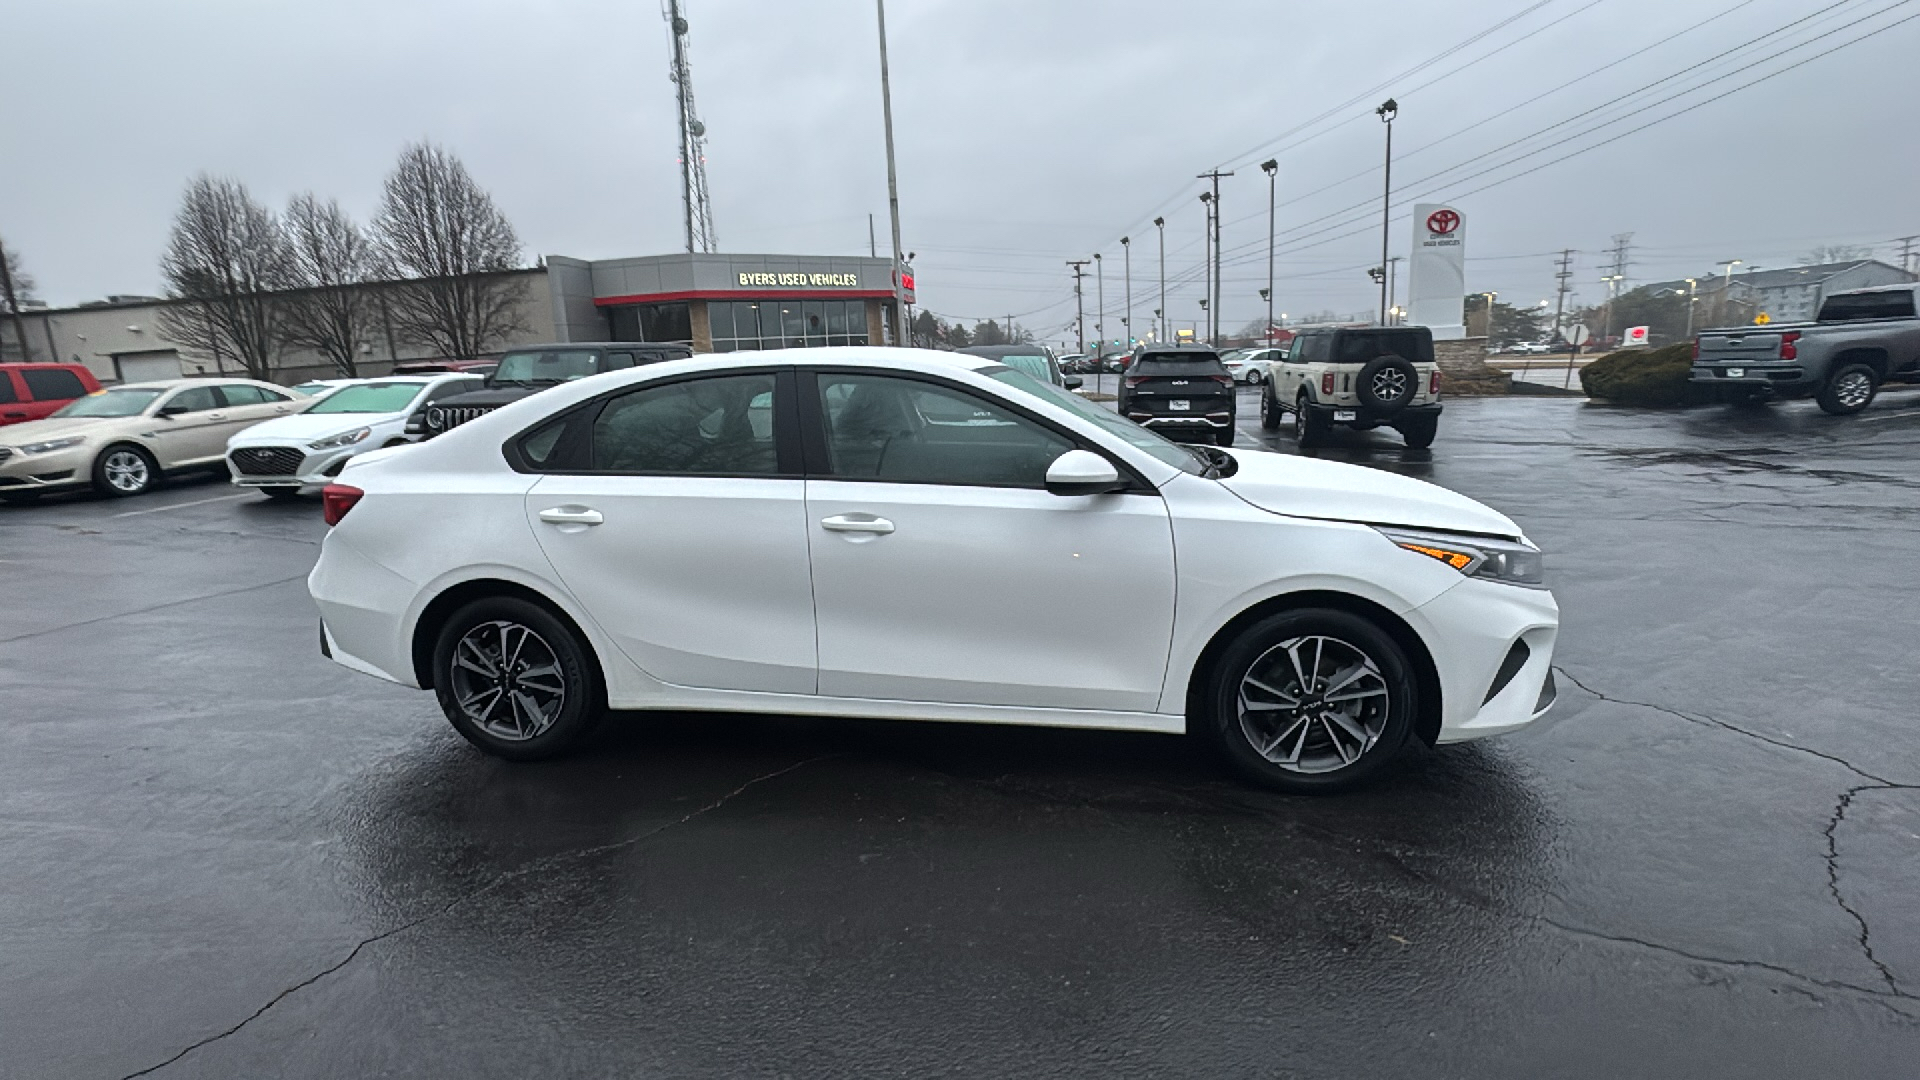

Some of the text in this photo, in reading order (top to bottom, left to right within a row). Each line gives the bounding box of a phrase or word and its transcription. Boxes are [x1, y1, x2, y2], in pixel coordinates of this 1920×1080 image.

[739, 272, 857, 287] BYERS USED VEHICLES
